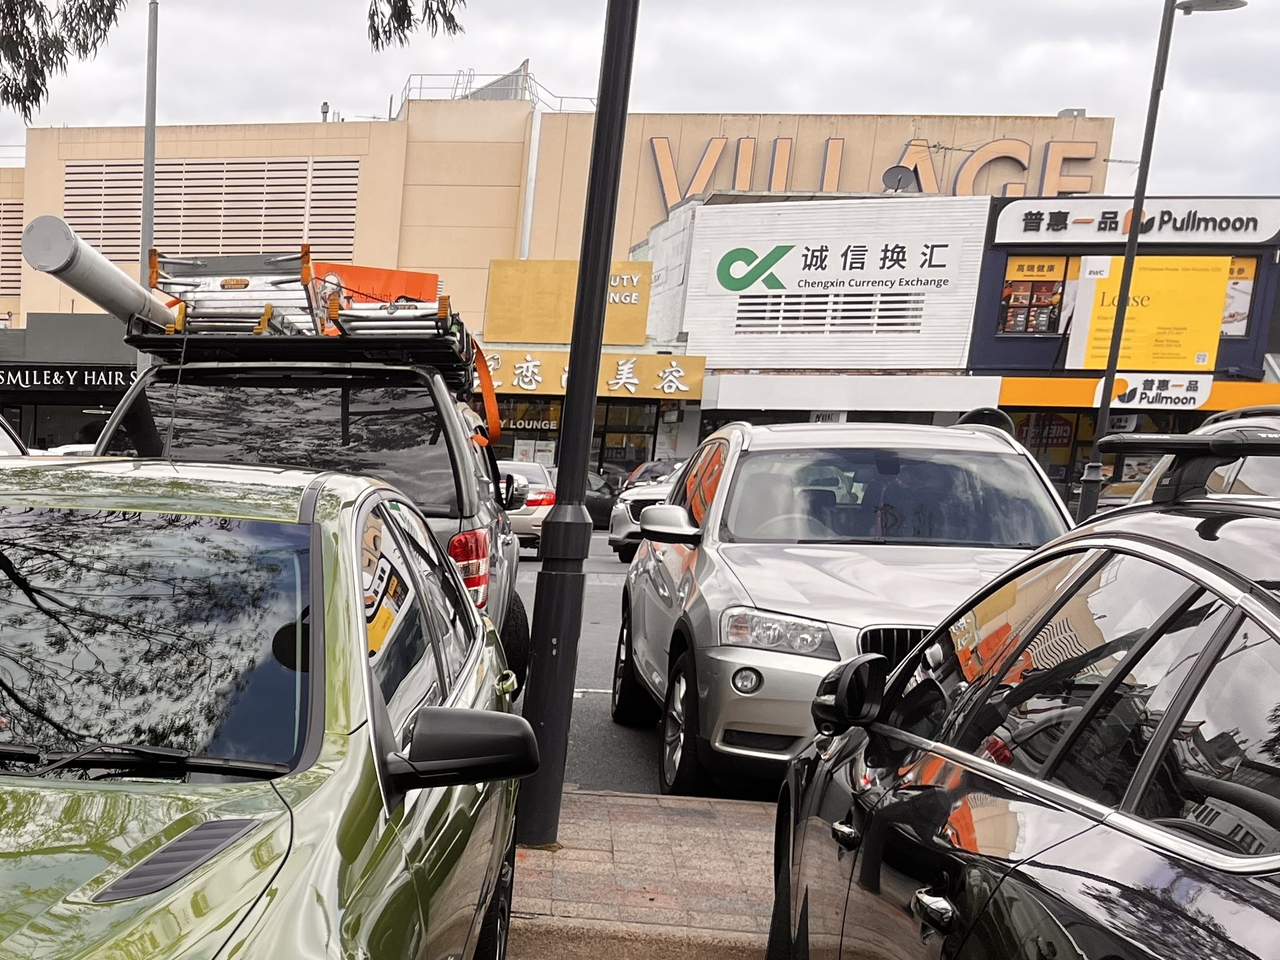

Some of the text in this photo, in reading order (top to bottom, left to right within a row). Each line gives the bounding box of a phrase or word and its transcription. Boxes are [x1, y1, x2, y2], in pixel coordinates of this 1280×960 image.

[1022, 210, 1120, 232] 普惠一品
[1158, 209, 1258, 233] Pullmoon
[801, 243, 949, 271] 诚信换汇
[610, 275, 641, 287] UTY
[797, 277, 949, 290] Chengxin Currency Exchange
[609, 292, 639, 304] NGE
[84, 371, 126, 386] HAIR
[1142, 379, 1199, 392] 普惠一品
[1139, 391, 1196, 406] Pullmoon
[510, 420, 558, 429] LOUNGE
